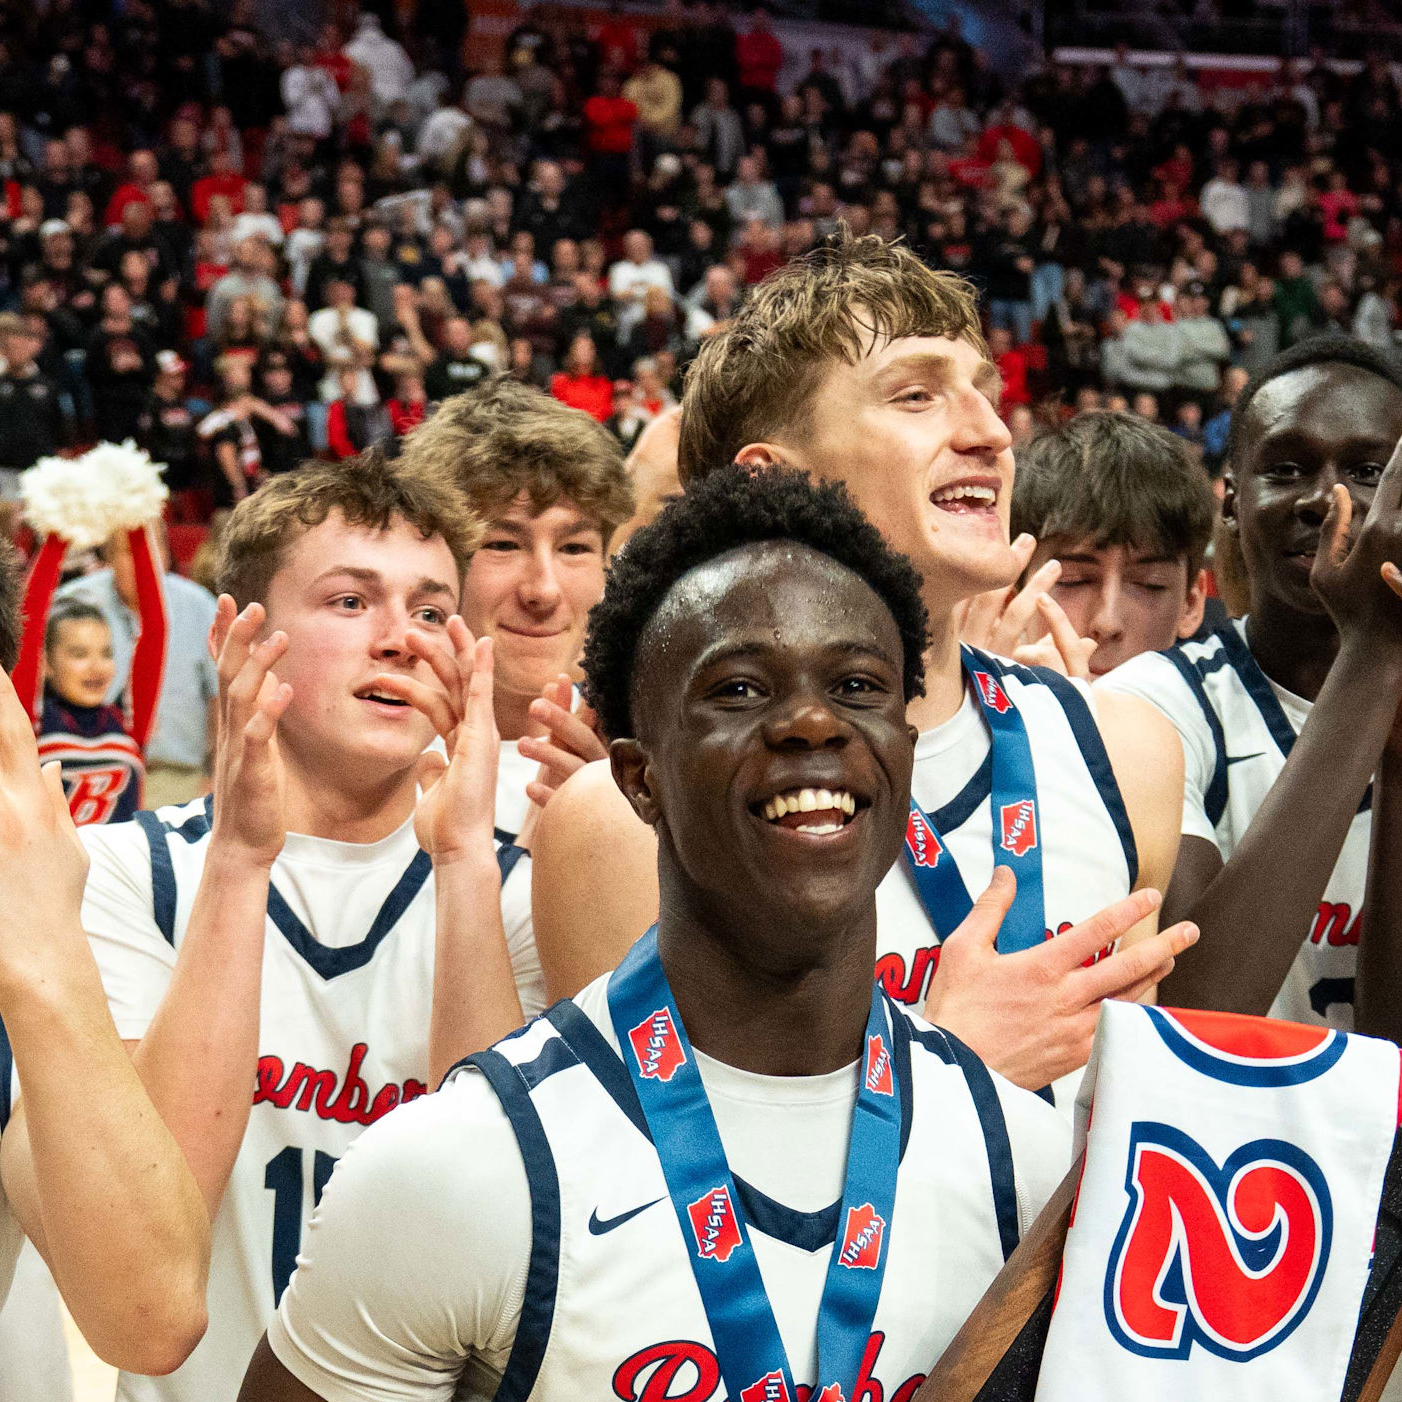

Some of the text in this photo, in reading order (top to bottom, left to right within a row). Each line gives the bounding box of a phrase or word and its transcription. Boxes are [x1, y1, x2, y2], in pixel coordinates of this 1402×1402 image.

[911, 814, 927, 862] IHSAA
[1006, 803, 1033, 847] IHSAA
[643, 1014, 669, 1074] IHSAA
[866, 1050, 888, 1089] IHSAA
[702, 1192, 728, 1254] IHSAA
[842, 1218, 881, 1264] IHSAA
